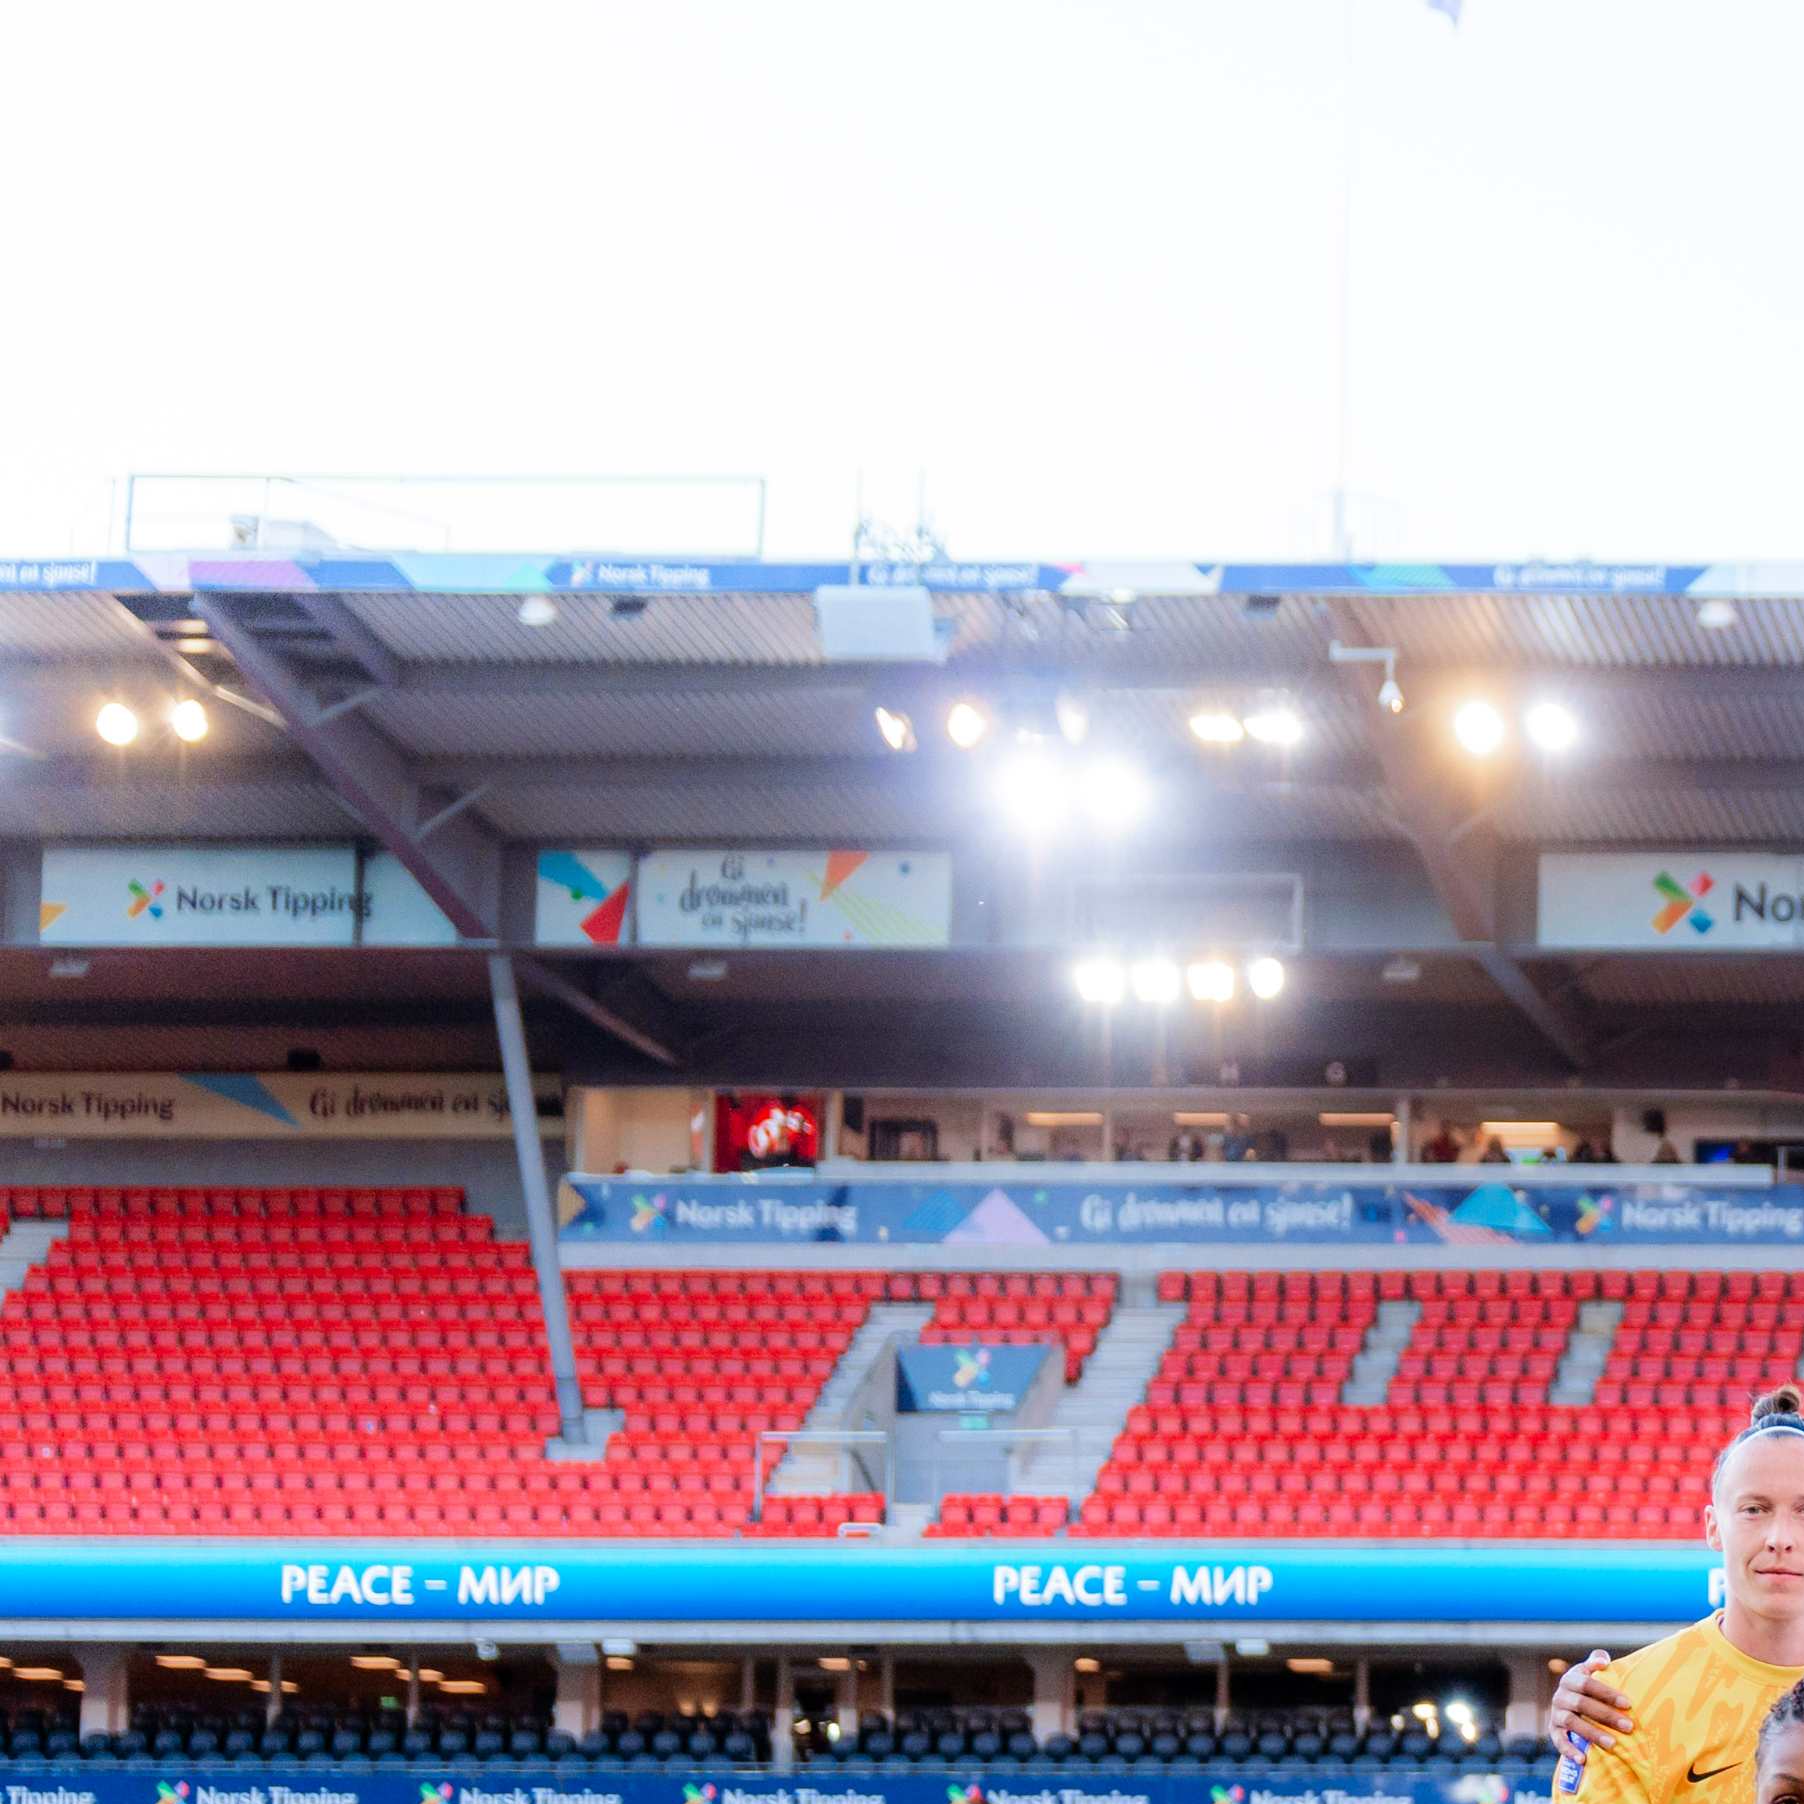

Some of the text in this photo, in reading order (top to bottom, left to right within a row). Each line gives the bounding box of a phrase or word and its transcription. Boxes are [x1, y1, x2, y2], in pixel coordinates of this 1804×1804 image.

[177, 886, 374, 921] Norsk Tipping
[1, 1092, 174, 1122] Norsk Tipping
[676, 1200, 858, 1235] Norsk Tipping
[1622, 1201, 1698, 1227] Norsk
[281, 1564, 415, 1606] PEACE
[457, 1564, 560, 1606] МИР
[993, 1565, 1128, 1606] PEACE
[1170, 1565, 1273, 1606] МИР
